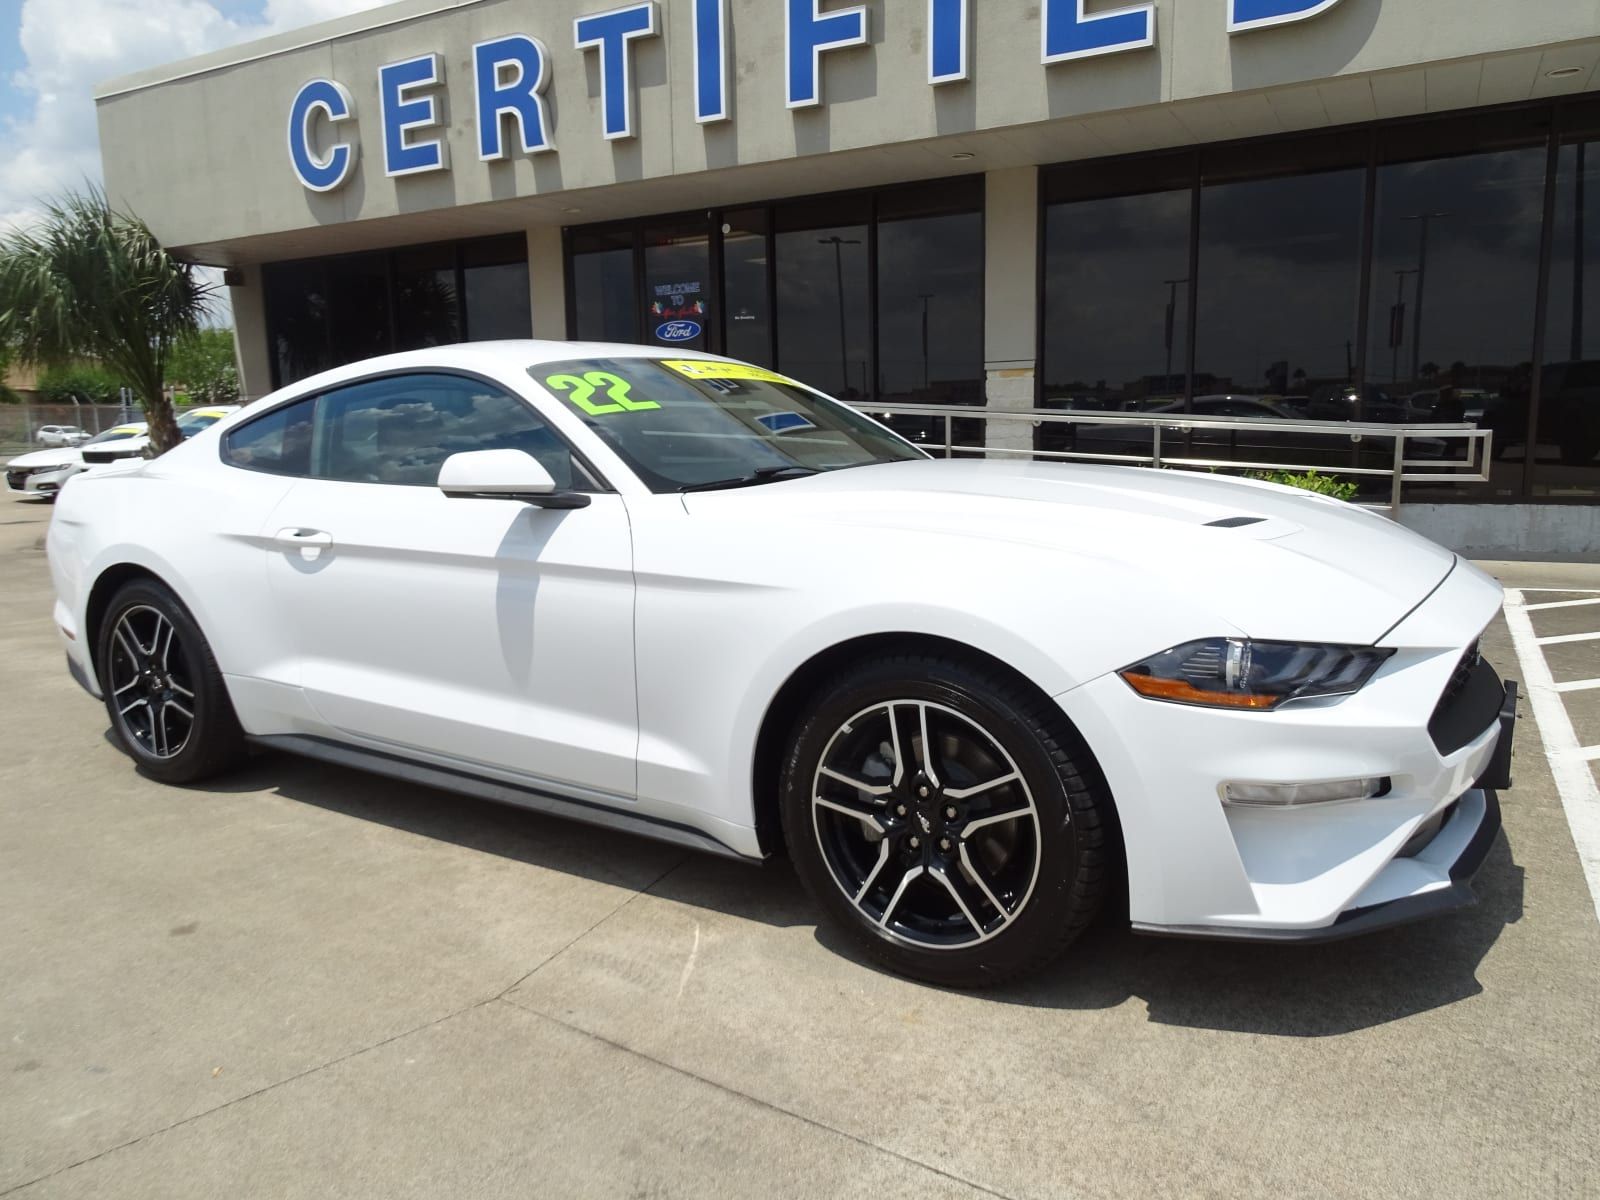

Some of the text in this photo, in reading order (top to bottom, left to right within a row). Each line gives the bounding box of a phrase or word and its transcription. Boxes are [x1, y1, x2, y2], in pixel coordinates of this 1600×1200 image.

[287, 0, 1344, 193] CERTIFI
[664, 323, 692, 338] Ford
[546, 371, 662, 416] 22
